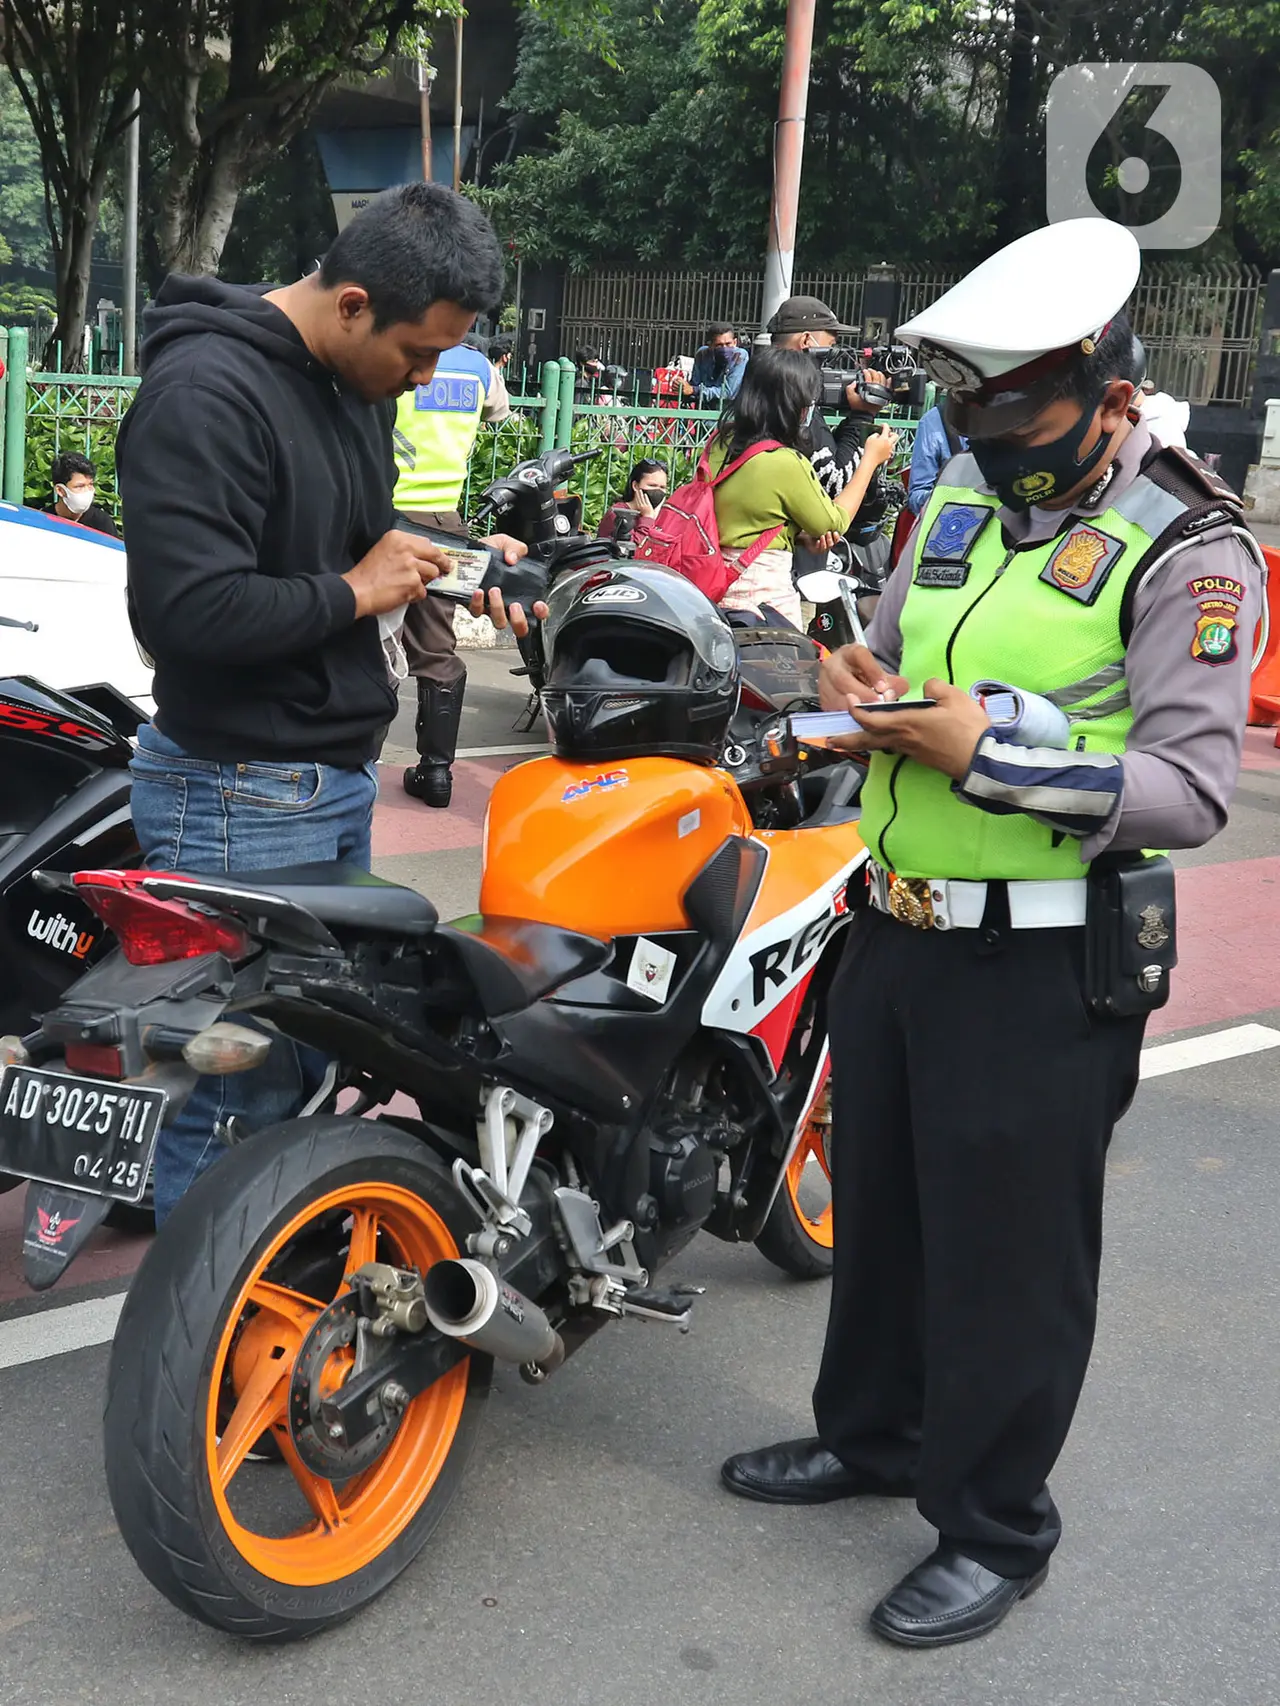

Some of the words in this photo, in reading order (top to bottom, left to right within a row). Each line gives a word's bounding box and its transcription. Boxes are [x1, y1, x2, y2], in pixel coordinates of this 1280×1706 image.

[1193, 578, 1241, 595] POLDA
[27, 909, 95, 959] withu
[4, 1077, 42, 1119] AD
[46, 1085, 118, 1134] 3025
[119, 1098, 152, 1143] HI
